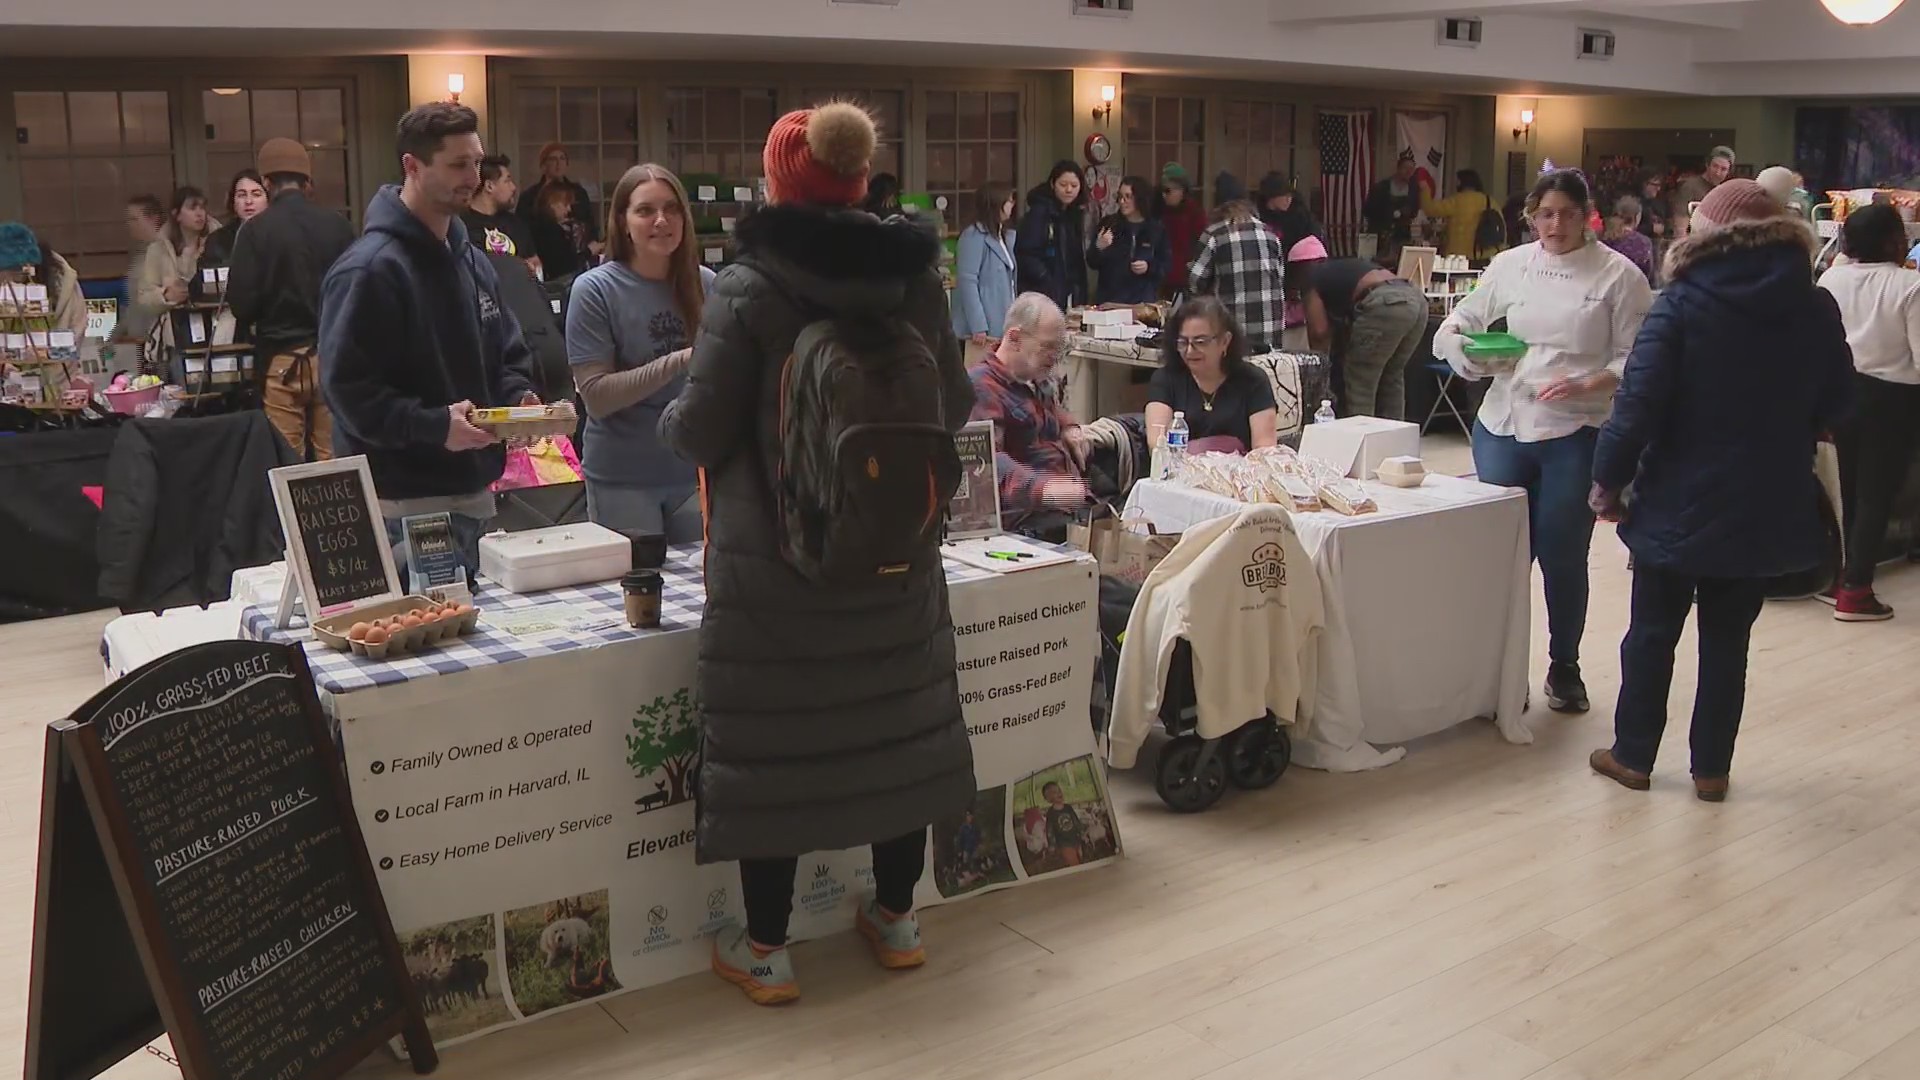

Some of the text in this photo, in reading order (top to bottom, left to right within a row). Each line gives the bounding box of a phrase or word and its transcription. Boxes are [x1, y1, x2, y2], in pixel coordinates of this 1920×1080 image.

[293, 479, 355, 508] PASTURE
[300, 504, 360, 531] RAISED
[317, 527, 358, 552] EGGS
[327, 556, 369, 577] $8/dz
[999, 608, 1038, 628] Raised
[1041, 600, 1087, 619] Chicken
[956, 636, 1069, 672] asture Raised Pork
[107, 651, 270, 732] 100% GRASS-FED BEEF
[958, 666, 1071, 705] 00% Grass-Fed Beef
[966, 700, 1066, 737] sture Raised Eggs
[391, 720, 593, 773] Family Owned & Operated
[127, 770, 157, 794] BEEF
[395, 768, 591, 820] Local Farm in Harvard, IL
[153, 786, 310, 877] PASTURE-RAISED PORK
[400, 812, 613, 869] Easy Home Delivery Service
[650, 926, 665, 936] No
[710, 910, 724, 920] No
[197, 900, 352, 1008] PASTURE-RAISED CHICKEN
[750, 966, 773, 977] HOKA
